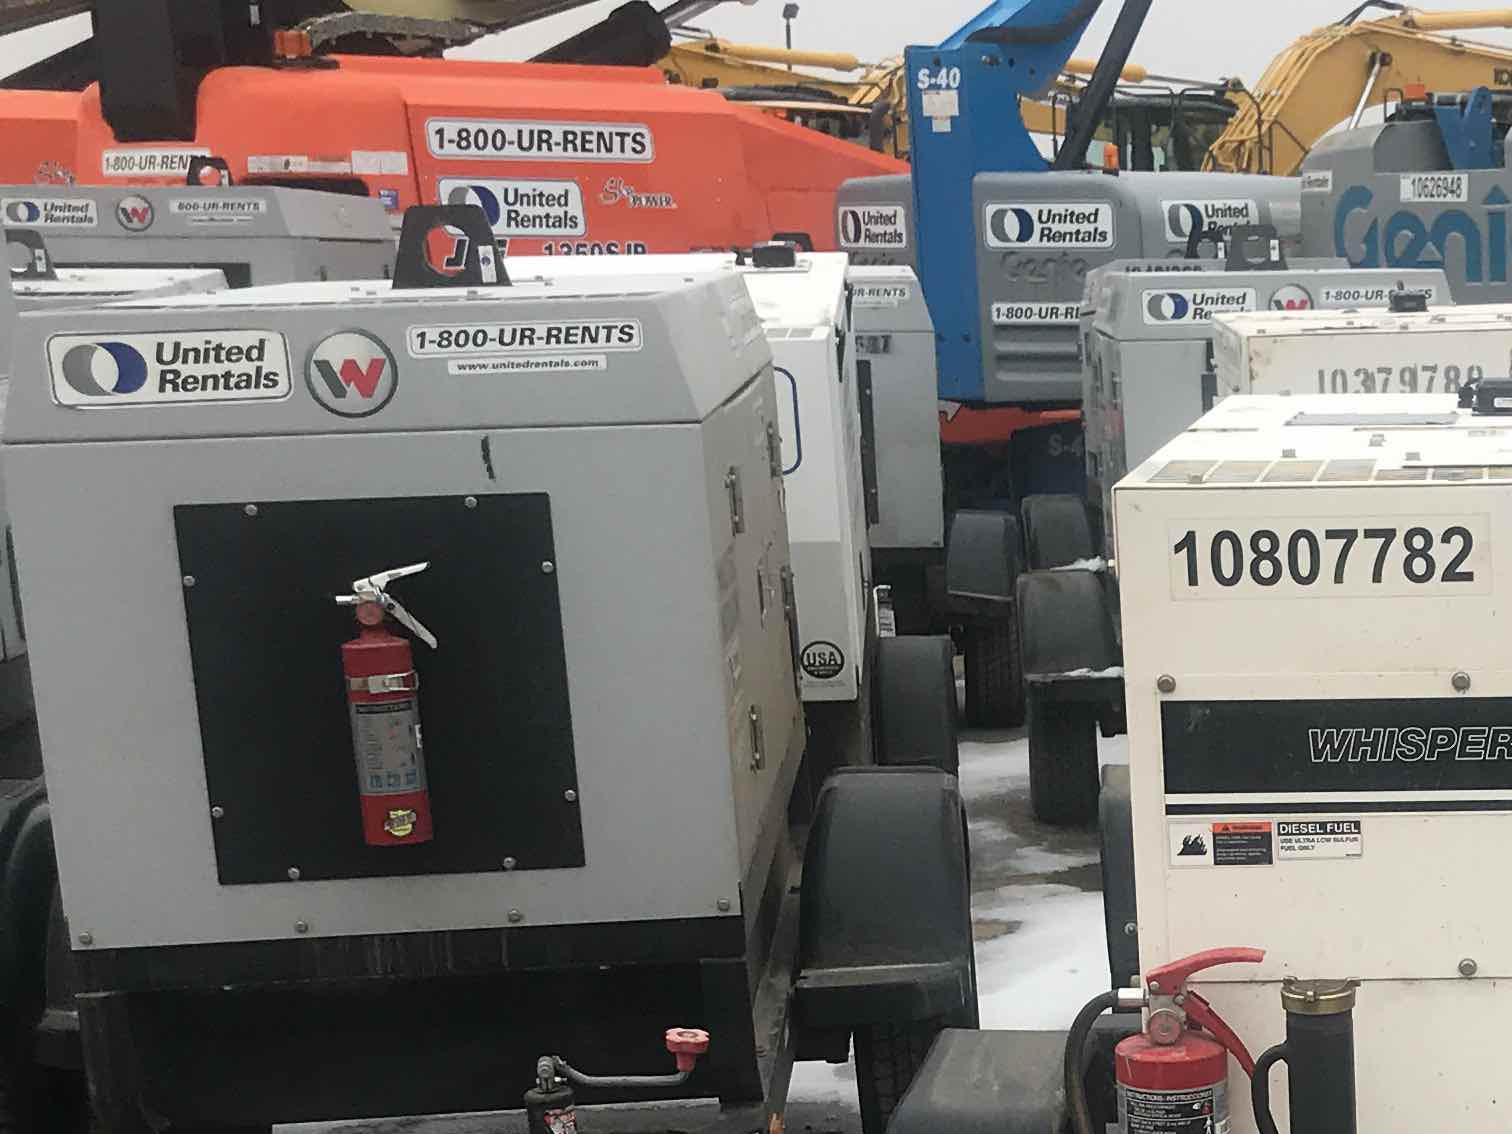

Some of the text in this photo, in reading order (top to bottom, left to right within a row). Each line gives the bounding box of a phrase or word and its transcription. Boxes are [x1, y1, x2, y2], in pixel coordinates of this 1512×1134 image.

[917, 67, 961, 89] S-40
[434, 127, 647, 155] 1-800-UR-RENTS
[104, 154, 192, 171] 1-800-UR-REN
[1410, 176, 1463, 200] 10626948
[503, 187, 569, 208] United
[506, 209, 579, 230] Rentals
[862, 210, 897, 225] United
[1038, 208, 1099, 225] United
[1204, 203, 1250, 219] United
[863, 228, 904, 243] Rentals
[1039, 227, 1108, 243] Rentals
[1192, 293, 1247, 306] United
[415, 322, 637, 351] 1-800-UR-RENTS
[155, 339, 266, 366] United
[456, 357, 600, 372] www.unitedrentals.com
[158, 366, 280, 393] Rentals
[1173, 526, 1475, 588] 10807782
[806, 651, 838, 665] USA
[1279, 822, 1359, 835] DIESEL FUEL
